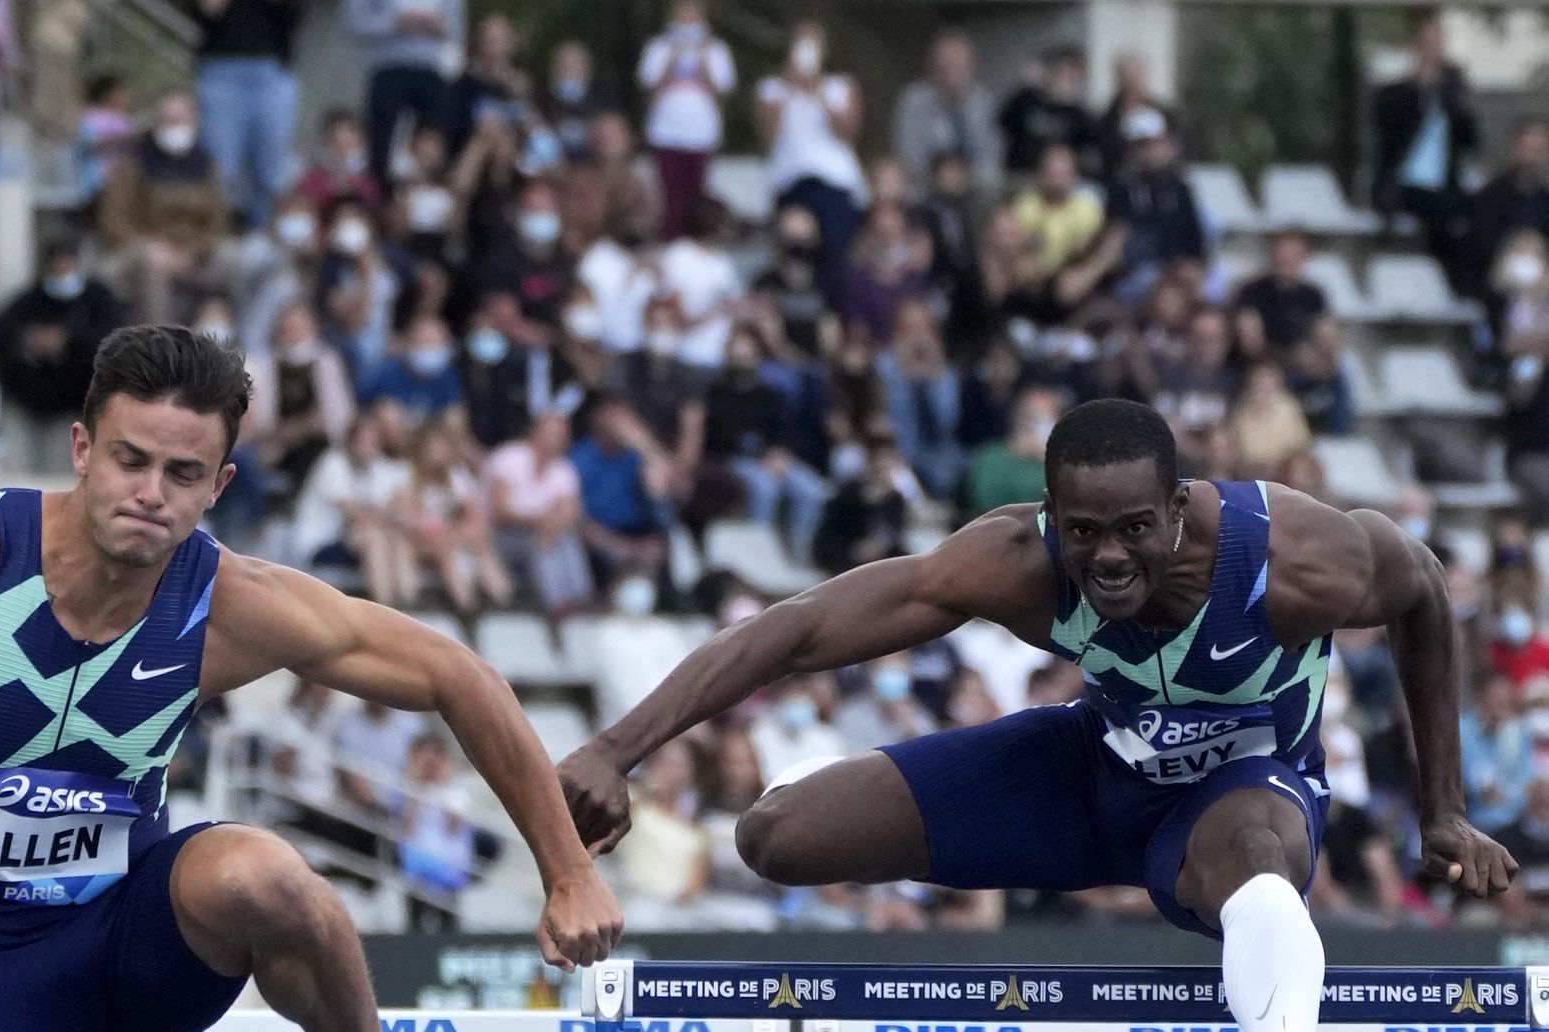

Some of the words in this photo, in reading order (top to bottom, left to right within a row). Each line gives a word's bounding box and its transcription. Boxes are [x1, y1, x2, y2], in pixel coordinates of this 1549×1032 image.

[1161, 716, 1243, 746] asics
[1134, 741, 1236, 779] LEVY
[27, 786, 107, 813] asics
[3, 885, 66, 901] PARIS
[637, 980, 735, 998] MEETING
[739, 981, 759, 998] DE
[762, 973, 837, 1008] PARIS
[864, 982, 963, 1000] MEETING
[966, 983, 986, 1000] DE
[990, 975, 1064, 1011] PARIS
[1092, 983, 1190, 1002] MEETING
[1193, 984, 1214, 1002] DE
[1320, 985, 1417, 1003] MEETING
[1421, 987, 1442, 1003] DE
[1445, 978, 1519, 1013] PARIS
